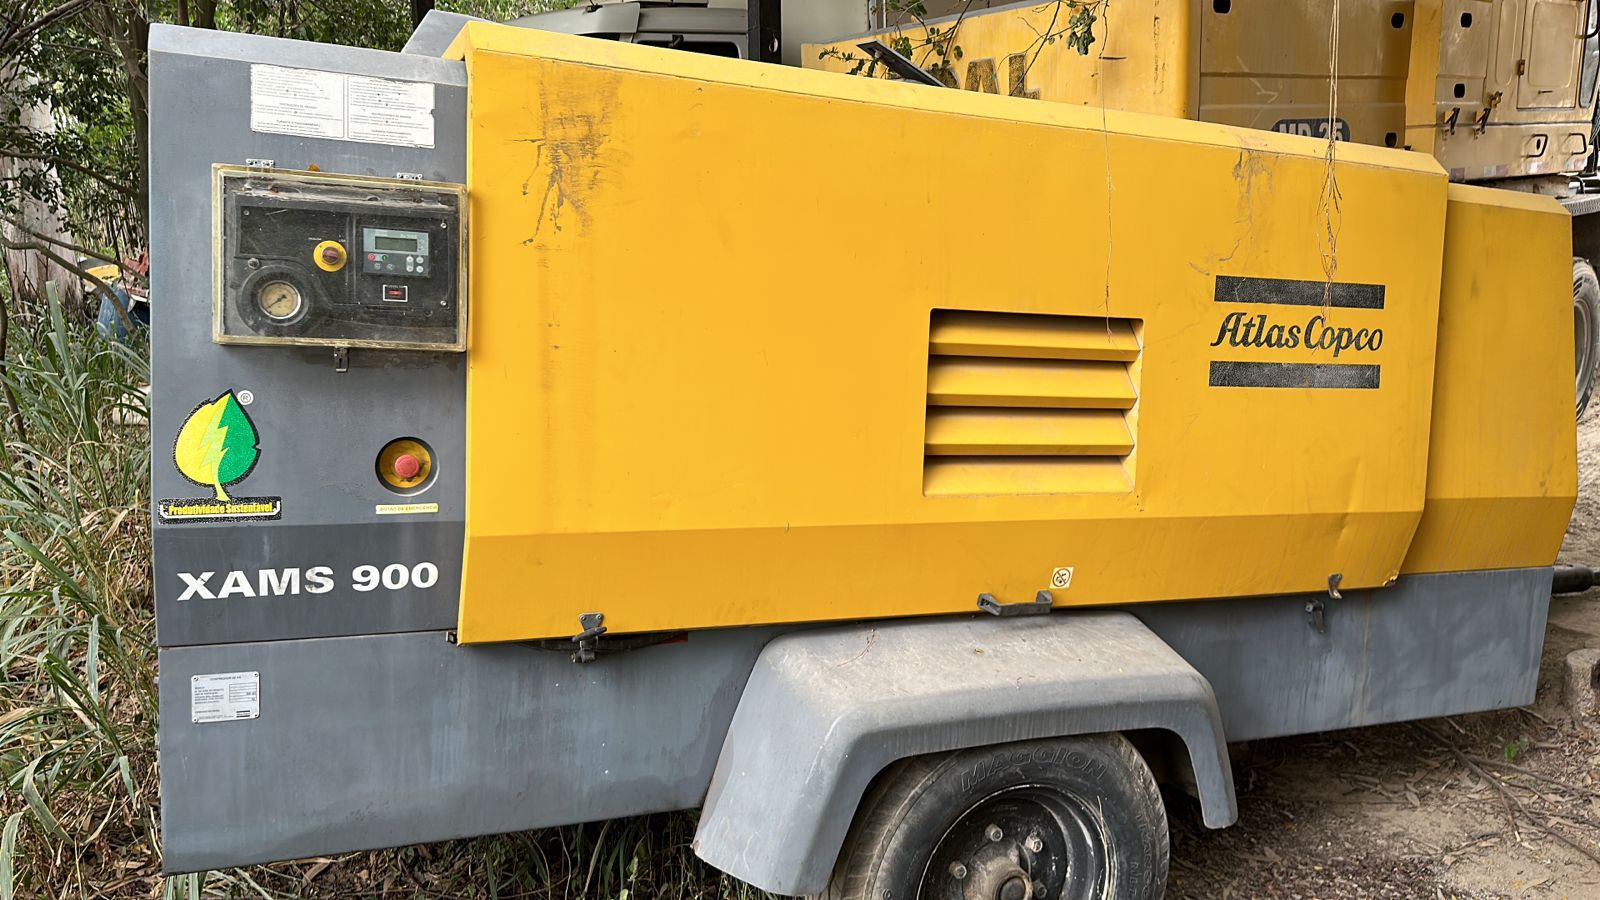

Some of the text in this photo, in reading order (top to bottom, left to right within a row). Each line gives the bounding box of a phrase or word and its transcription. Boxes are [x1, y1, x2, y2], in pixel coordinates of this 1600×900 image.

[1210, 312, 1383, 357] Atlas Copco
[177, 562, 439, 601] XAMS 900
[961, 746, 1108, 792] MAGGION
